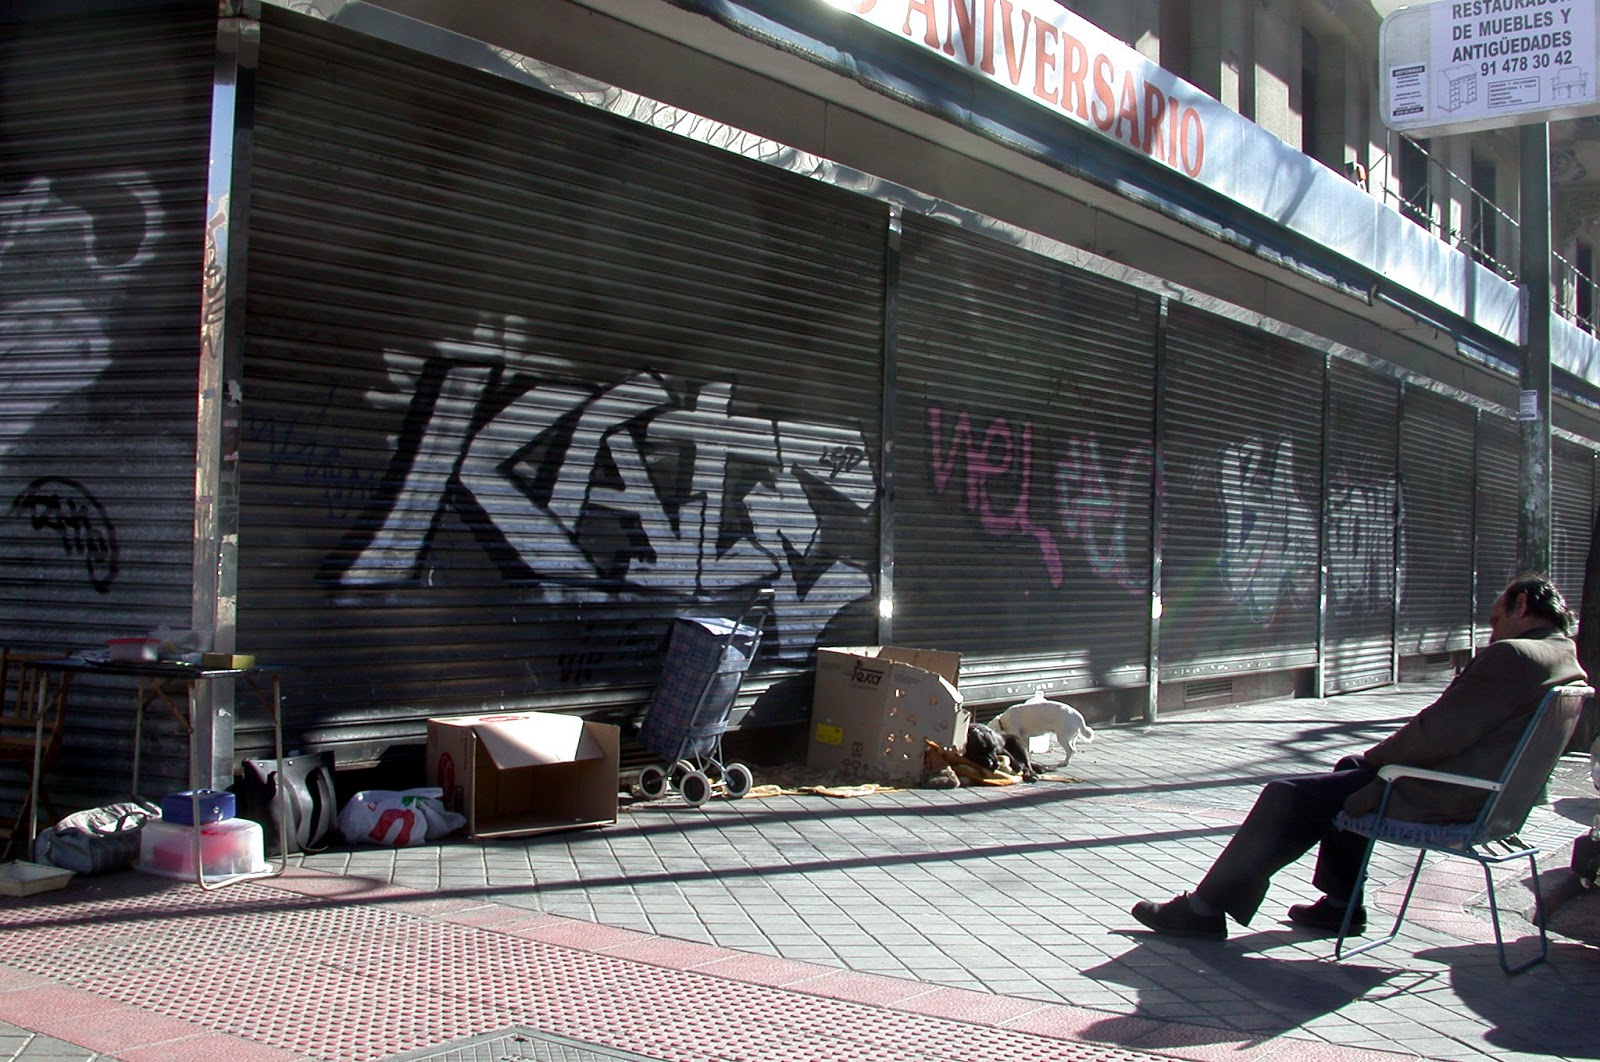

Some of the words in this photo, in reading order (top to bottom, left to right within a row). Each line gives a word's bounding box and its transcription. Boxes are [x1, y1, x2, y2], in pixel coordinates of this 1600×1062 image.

[1452, 0, 1570, 19] RESTAURA
[1452, 25, 1472, 41] DE
[1479, 11, 1553, 37] MUEBLES
[1560, 8, 1572, 24] Y
[1452, 30, 1572, 63] ANTIGÜEDADES
[1481, 61, 1496, 77] 91
[1502, 56, 1528, 74] 478
[1532, 54, 1550, 69] 30
[1554, 50, 1572, 66] 42
[903, 0, 1204, 178] ANIVERSARIO
